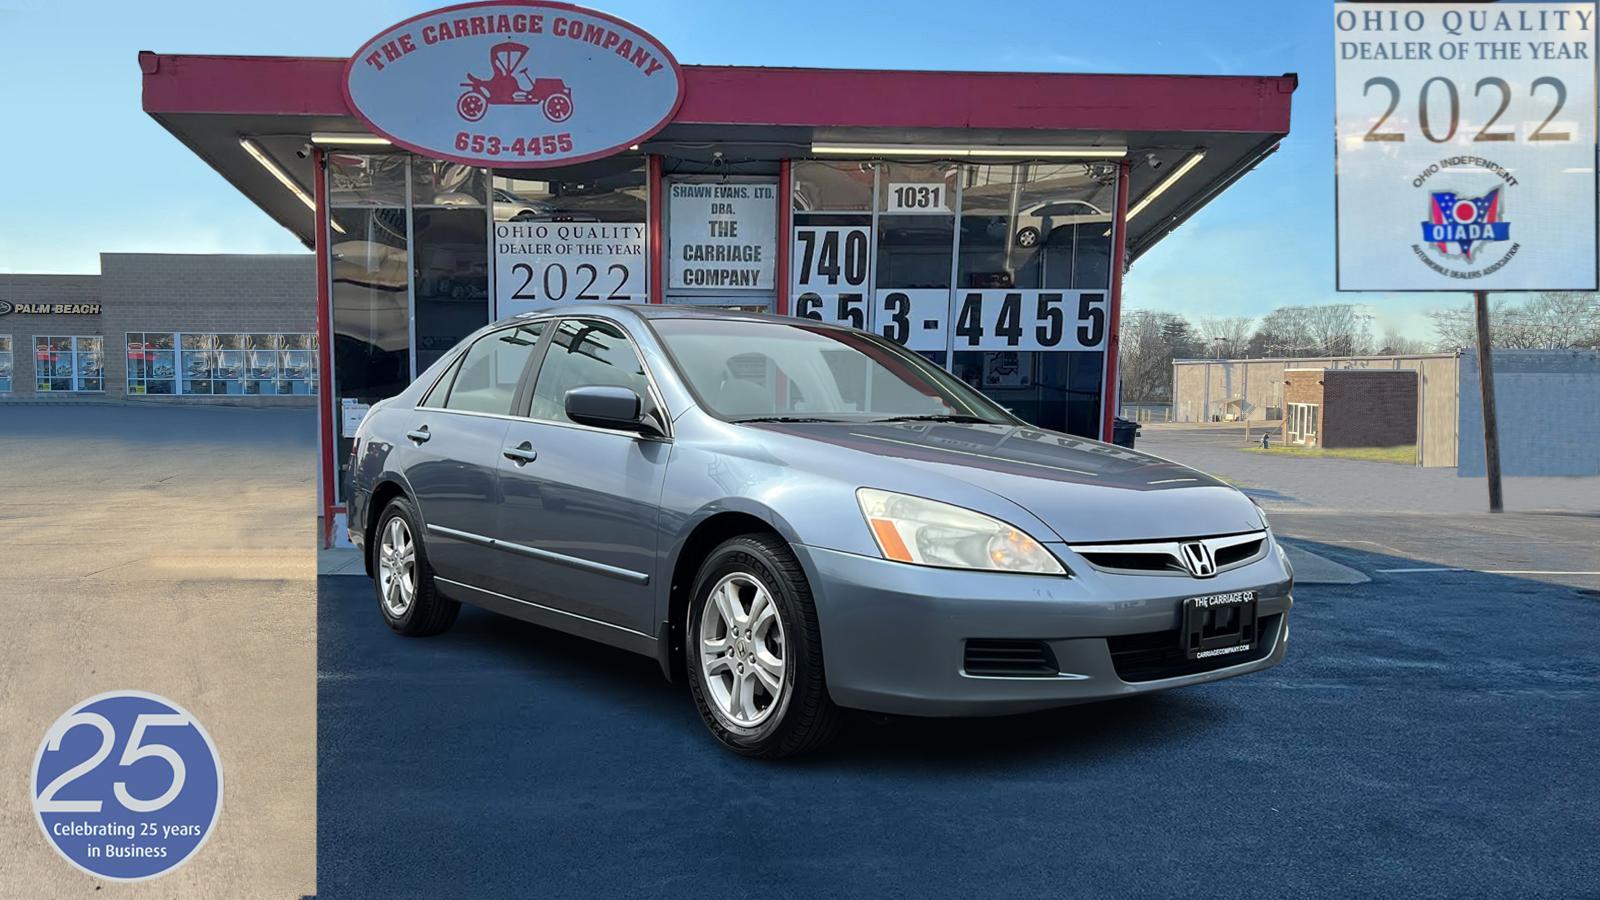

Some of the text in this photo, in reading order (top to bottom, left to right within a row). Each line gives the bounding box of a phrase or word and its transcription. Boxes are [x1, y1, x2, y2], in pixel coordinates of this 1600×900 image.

[1336, 9, 1593, 36] OHIO QUALITY
[365, 14, 664, 78] THE CARRIAGE COMPANY
[1340, 41, 1589, 60] DEALER OF THE YEAR
[1362, 75, 1571, 143] 2022
[455, 132, 573, 156] 653-4455
[1412, 155, 1519, 188] OHIO INDEPENDENT
[672, 186, 775, 199] SHAWN EVANS. LTD.
[894, 186, 941, 208] 1031
[711, 203, 736, 215] DBA.
[497, 226, 644, 241] OHIO QUALITY
[708, 220, 738, 237] THE
[1432, 225, 1495, 240] OIADA
[499, 243, 641, 255] DEALER OF THE YEAR
[683, 244, 762, 262] CARRIAGE
[797, 229, 868, 285] 740
[1411, 242, 1521, 280] AUTOMOBILE DEALERS ASSOCIATION
[511, 262, 632, 301] 2022
[683, 268, 761, 286] COMPANY
[14, 303, 100, 314] PALM BEACH
[1195, 596, 1208, 608] THE
[1208, 592, 1243, 605] CARRIAGE
